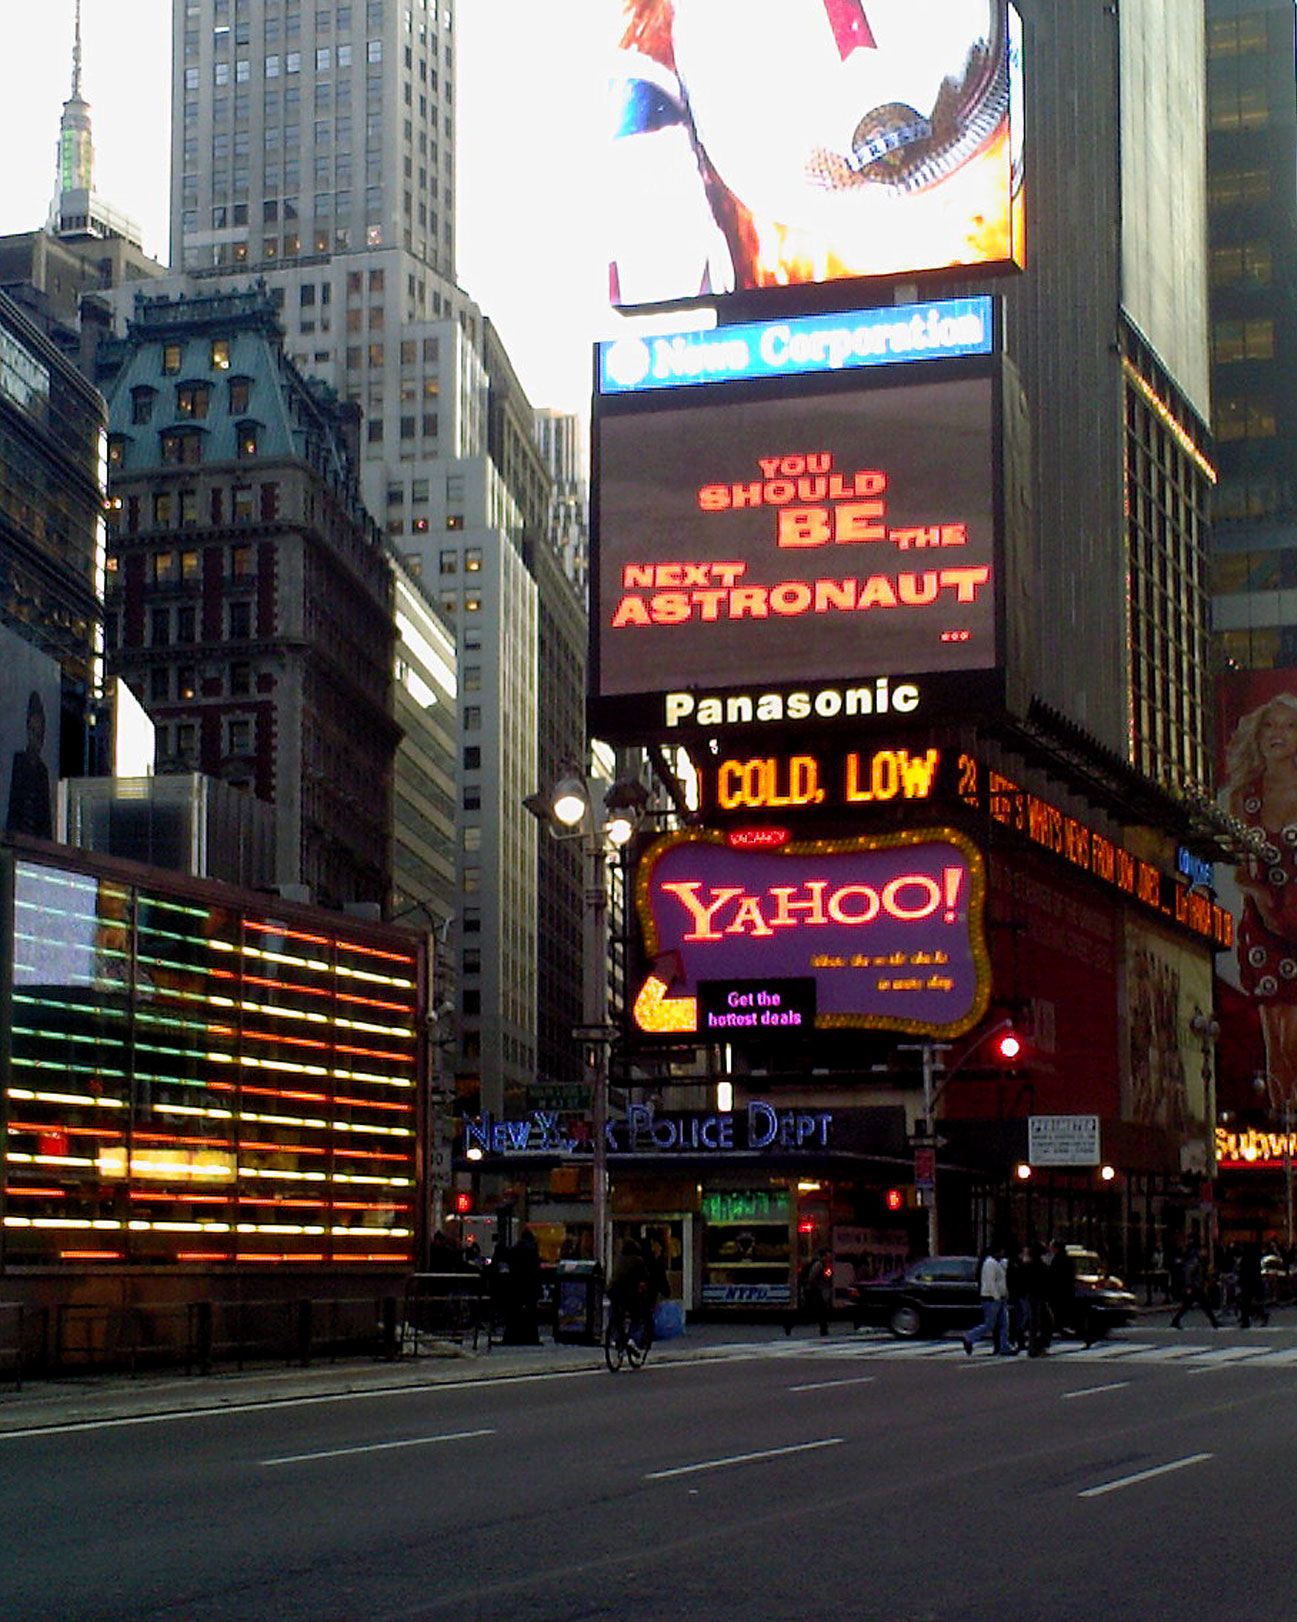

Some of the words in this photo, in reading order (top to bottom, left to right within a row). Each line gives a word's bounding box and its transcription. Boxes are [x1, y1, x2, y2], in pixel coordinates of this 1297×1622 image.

[760, 309, 984, 368] Corporation
[758, 452, 833, 479] YOU
[698, 470, 887, 511] SHOULD
[777, 499, 887, 548] BE
[889, 522, 968, 550] THE
[611, 566, 990, 628] ASTRONAUT
[623, 561, 748, 589] NEXT
[665, 677, 920, 727] Panasonic
[847, 749, 939, 801] LOW
[660, 866, 964, 941] YAHOO!
[708, 1012, 758, 1028] hottest
[761, 1010, 802, 1026] deals
[727, 991, 754, 1008] Get
[757, 990, 781, 1007] the
[627, 1103, 734, 1149] POLICE
[748, 1101, 833, 1149] DEPT
